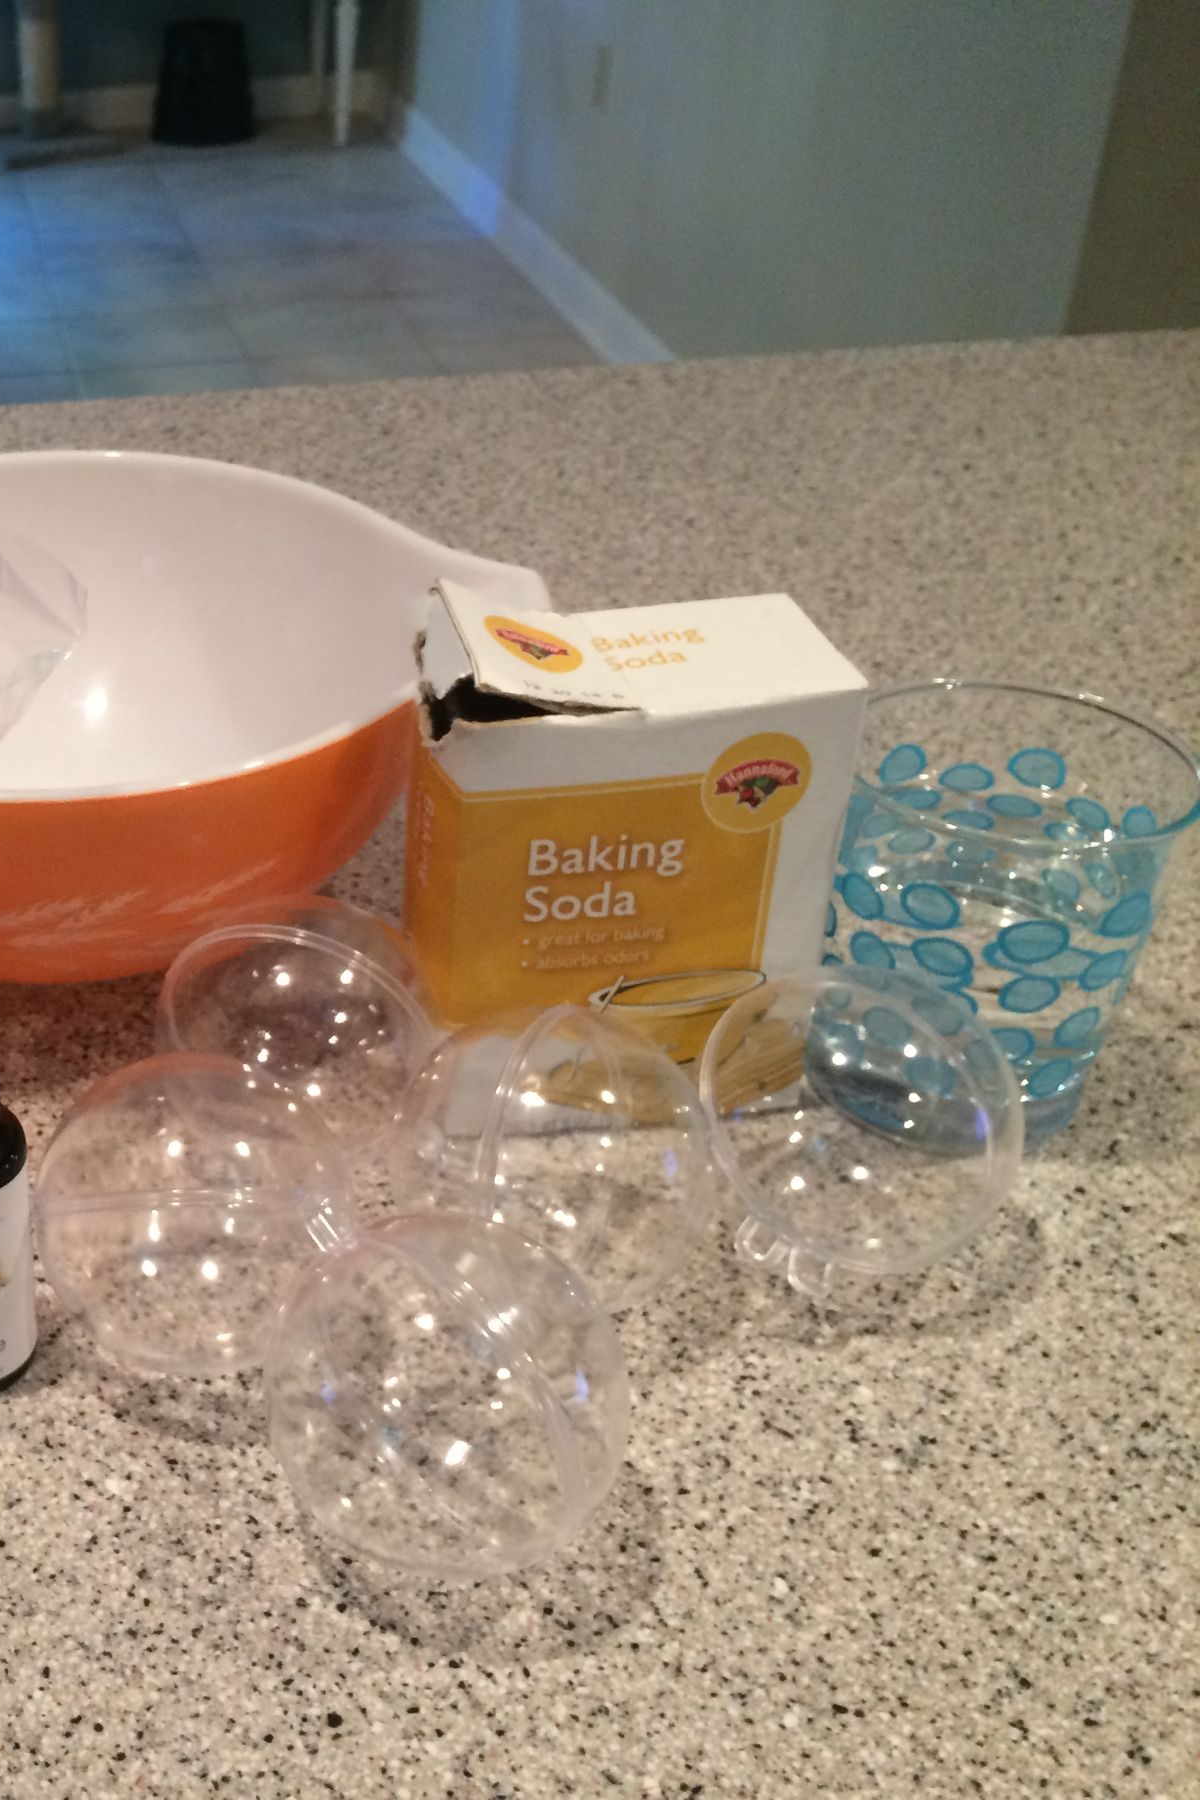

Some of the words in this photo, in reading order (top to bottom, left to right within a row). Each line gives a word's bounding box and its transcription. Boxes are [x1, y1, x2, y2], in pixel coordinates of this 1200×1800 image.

[591, 628, 704, 653] Baking
[604, 650, 688, 671] Soda
[527, 834, 685, 876] Baking
[523, 881, 636, 923] Soda
